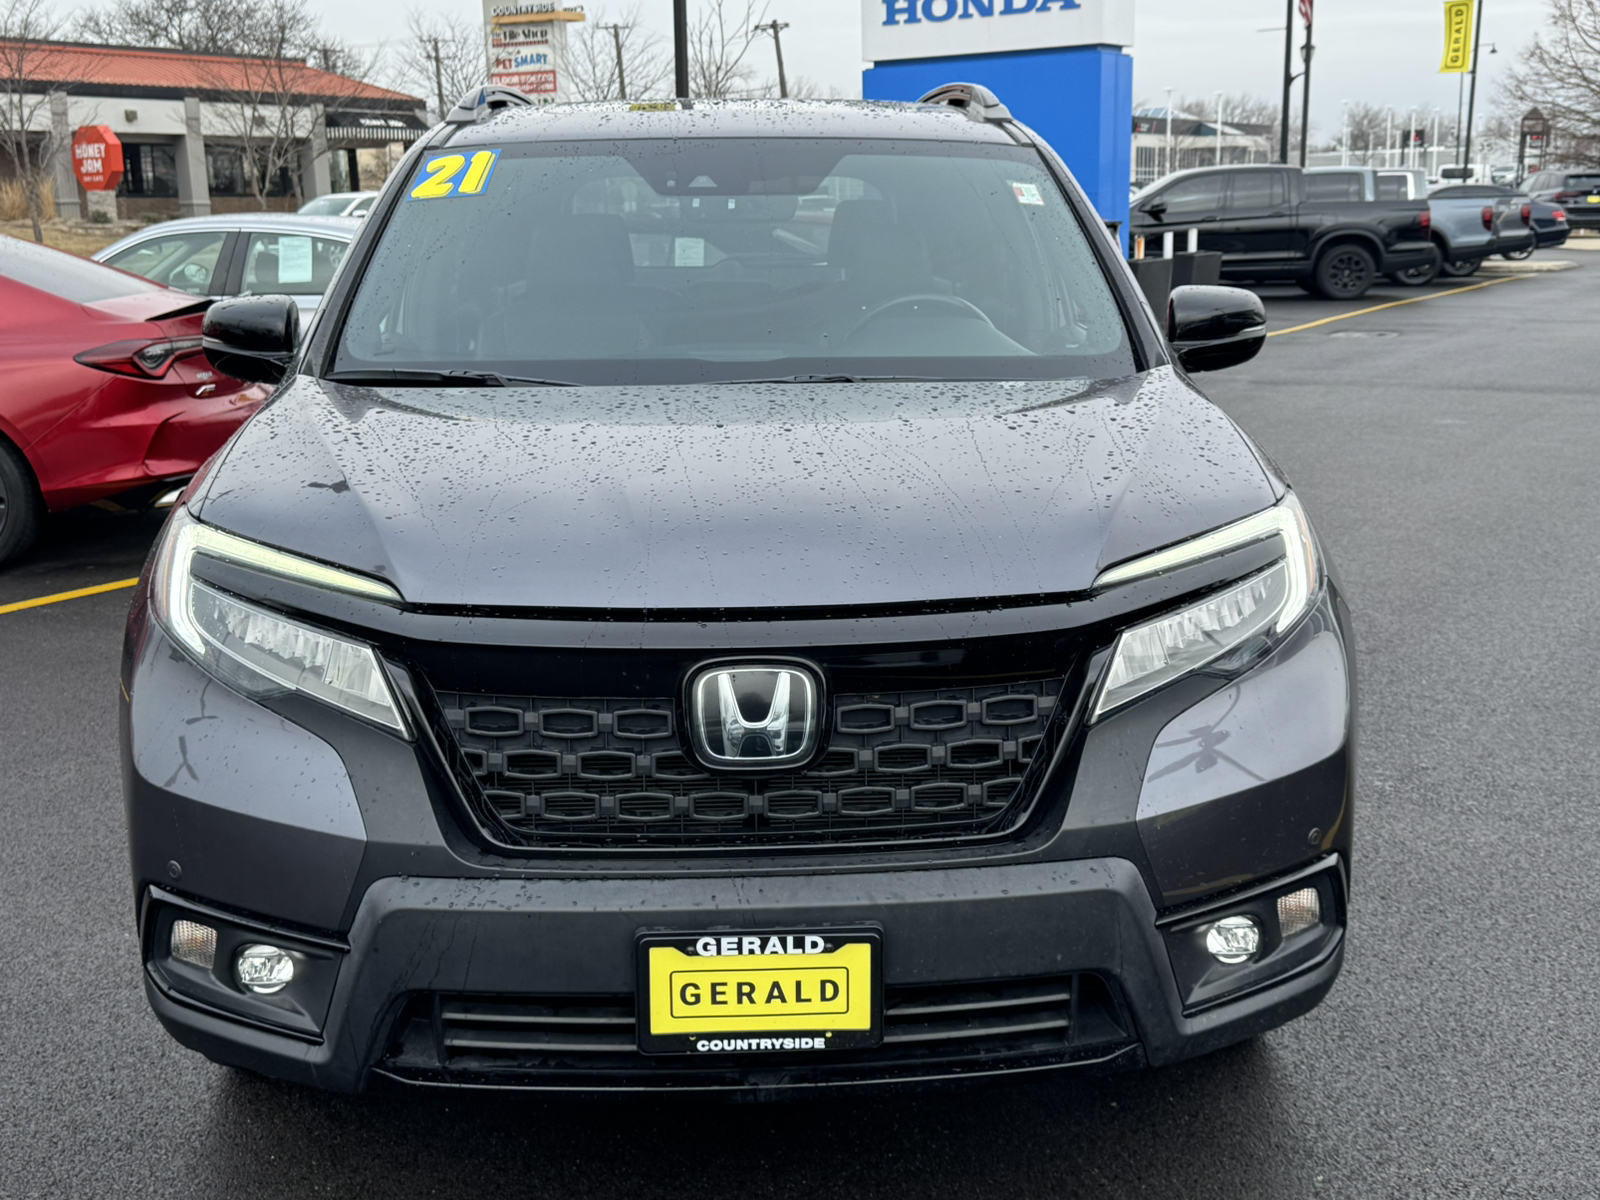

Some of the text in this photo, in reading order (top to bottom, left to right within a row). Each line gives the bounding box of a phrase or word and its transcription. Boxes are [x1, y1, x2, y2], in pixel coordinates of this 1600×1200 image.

[492, 3, 555, 16] COUNTRYSIDE
[1450, 9, 1464, 63] GERALD
[74, 142, 106, 160] HONEY
[80, 158, 103, 174] JAM
[411, 150, 497, 199] 21
[695, 935, 826, 957] GERALD
[679, 979, 841, 1007] GERALD
[696, 1037, 827, 1052] COUNTRYSIDE
